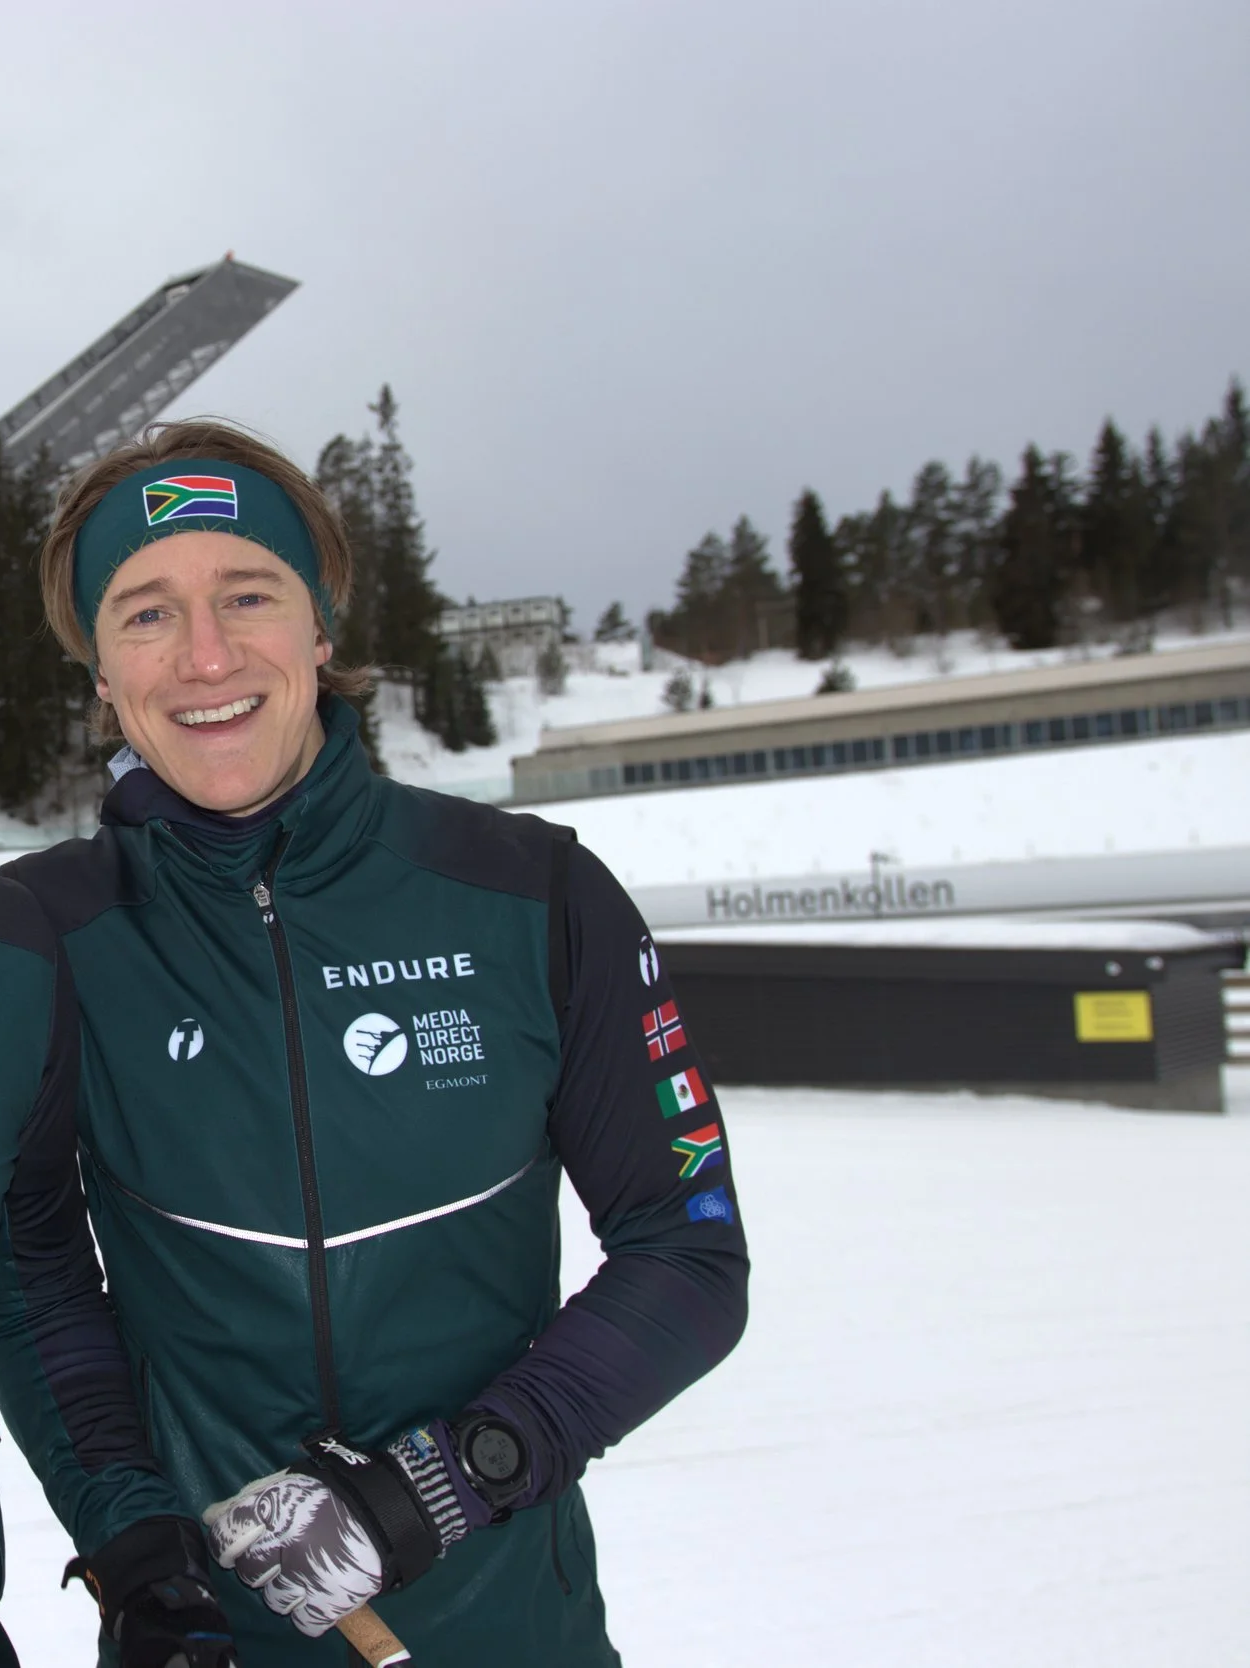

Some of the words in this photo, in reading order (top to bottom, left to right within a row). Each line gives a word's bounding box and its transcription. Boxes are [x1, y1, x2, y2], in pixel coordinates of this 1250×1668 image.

[706, 872, 955, 919] Holmenkollen
[321, 953, 475, 990] ENDURE
[412, 1008, 471, 1031] MEDIA
[415, 1025, 481, 1049] DIRECT
[419, 1043, 485, 1066] NORGE
[425, 1074, 489, 1091] EGMONT
